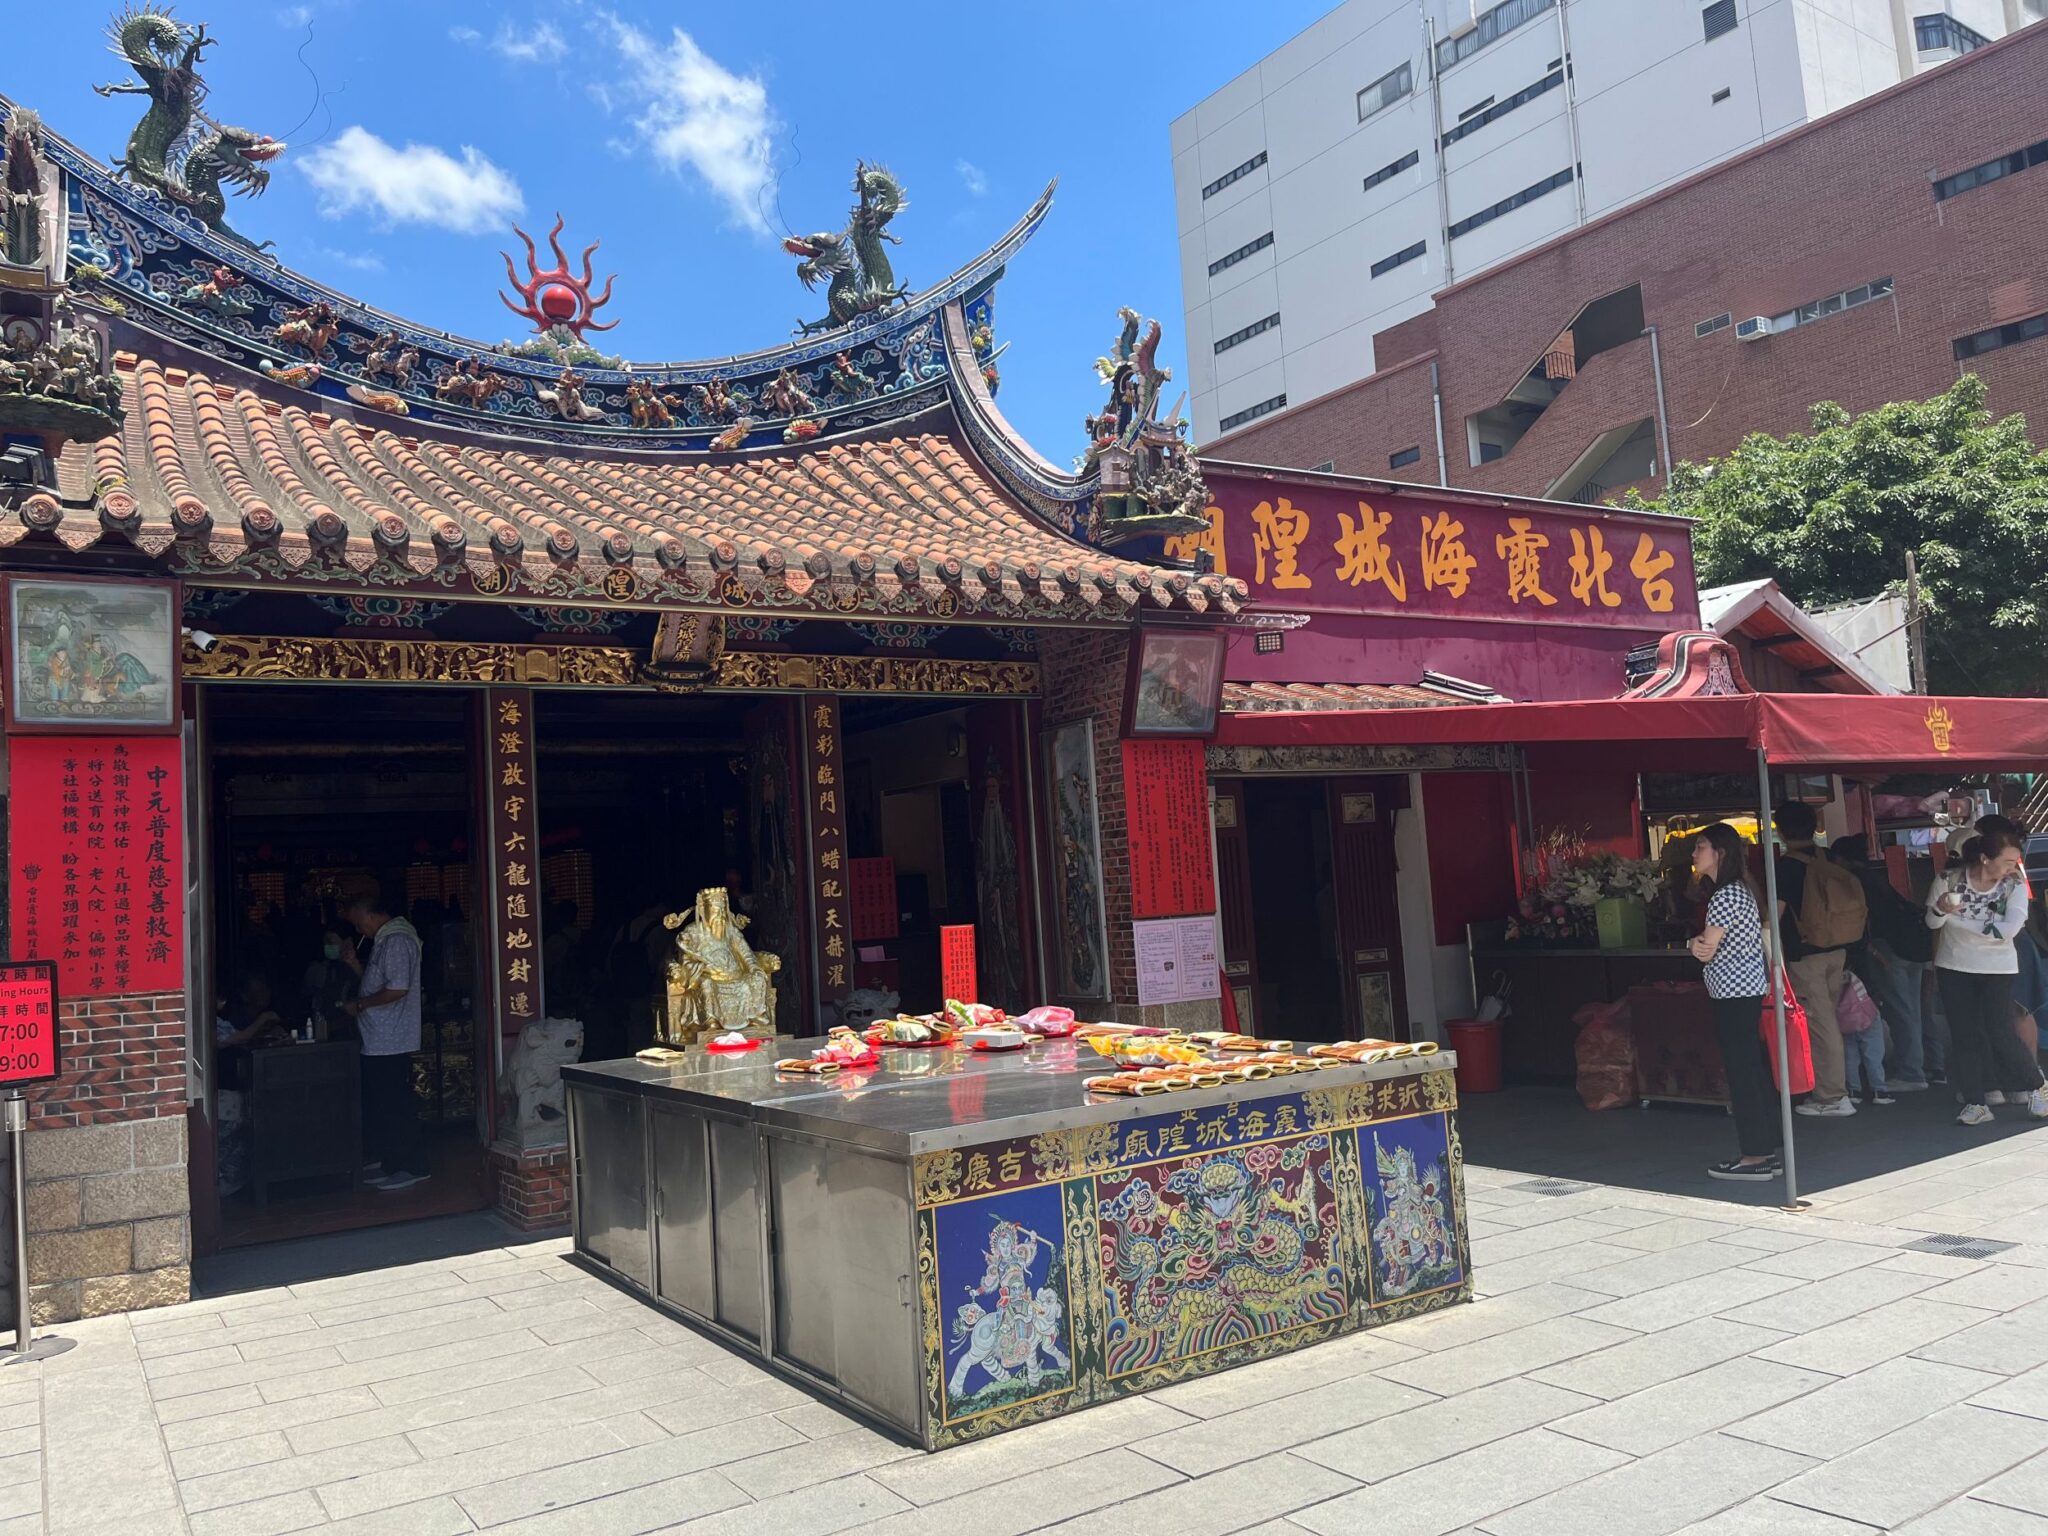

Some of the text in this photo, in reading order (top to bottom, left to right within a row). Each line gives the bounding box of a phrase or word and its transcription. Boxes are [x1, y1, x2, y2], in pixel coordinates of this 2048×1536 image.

[607, 571, 631, 597] 隍
[145, 765, 173, 963] 中元普度慈善救濟
[20, 987, 49, 996] Hours
[1377, 1080, 1421, 1113] 祈求
[1120, 1104, 1301, 1163] 霞海城隍廟
[963, 1148, 1027, 1191] 吉慶
